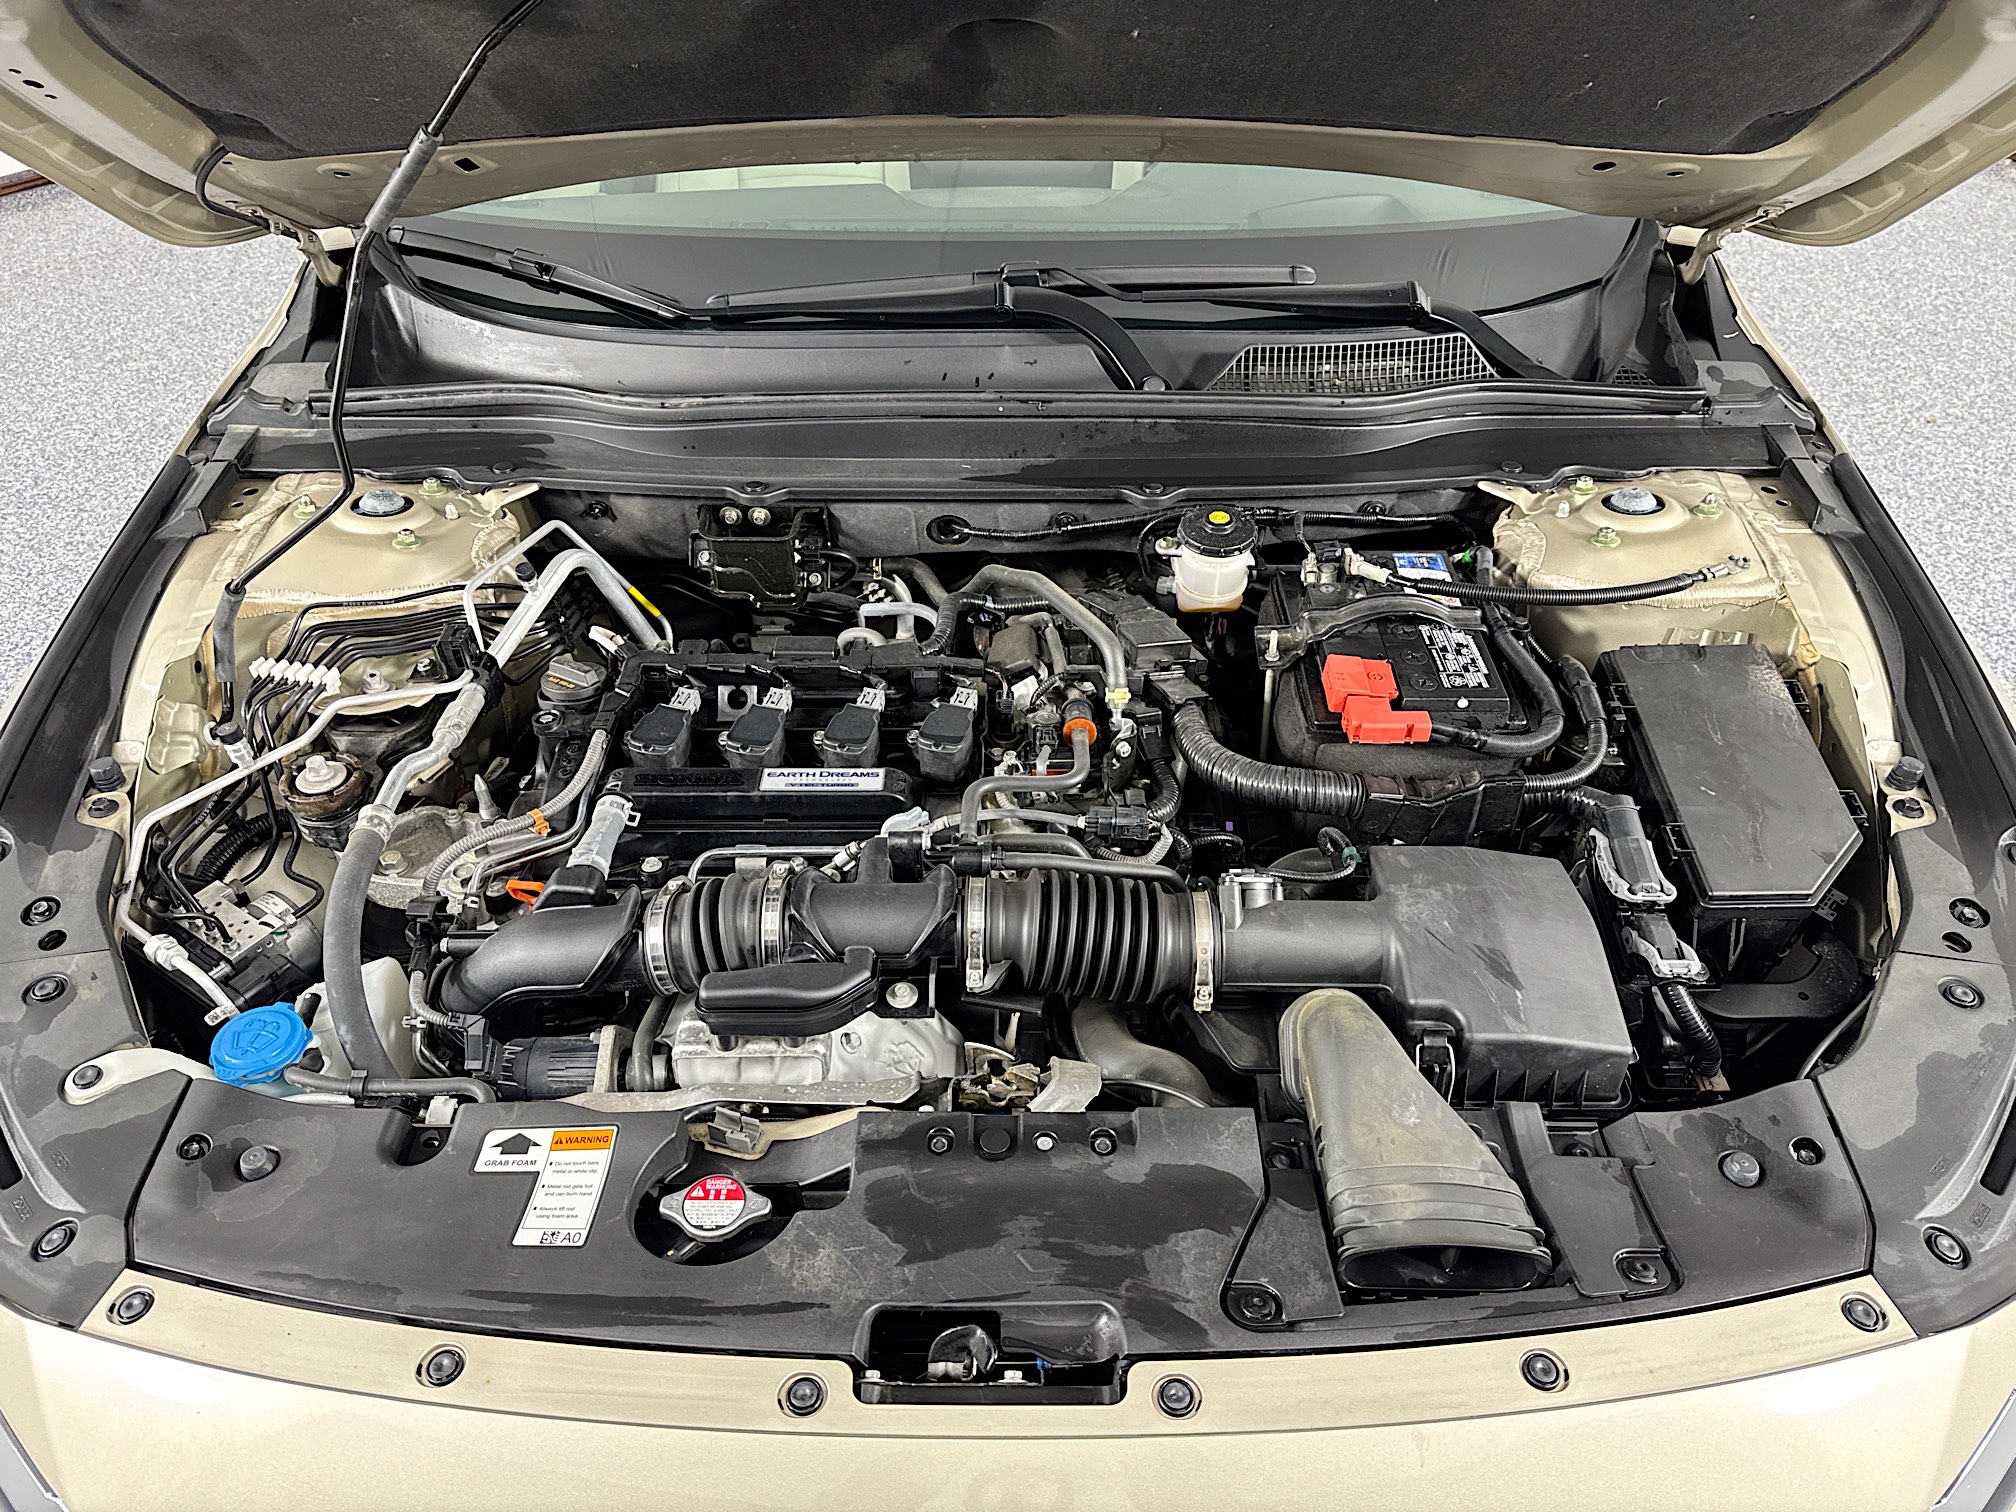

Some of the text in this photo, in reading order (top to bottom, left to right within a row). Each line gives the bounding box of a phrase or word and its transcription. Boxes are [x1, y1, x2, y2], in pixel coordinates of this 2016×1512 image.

[633, 773, 745, 786] HONDA
[565, 1135, 609, 1144] WARNING
[560, 1232, 582, 1244] A0
